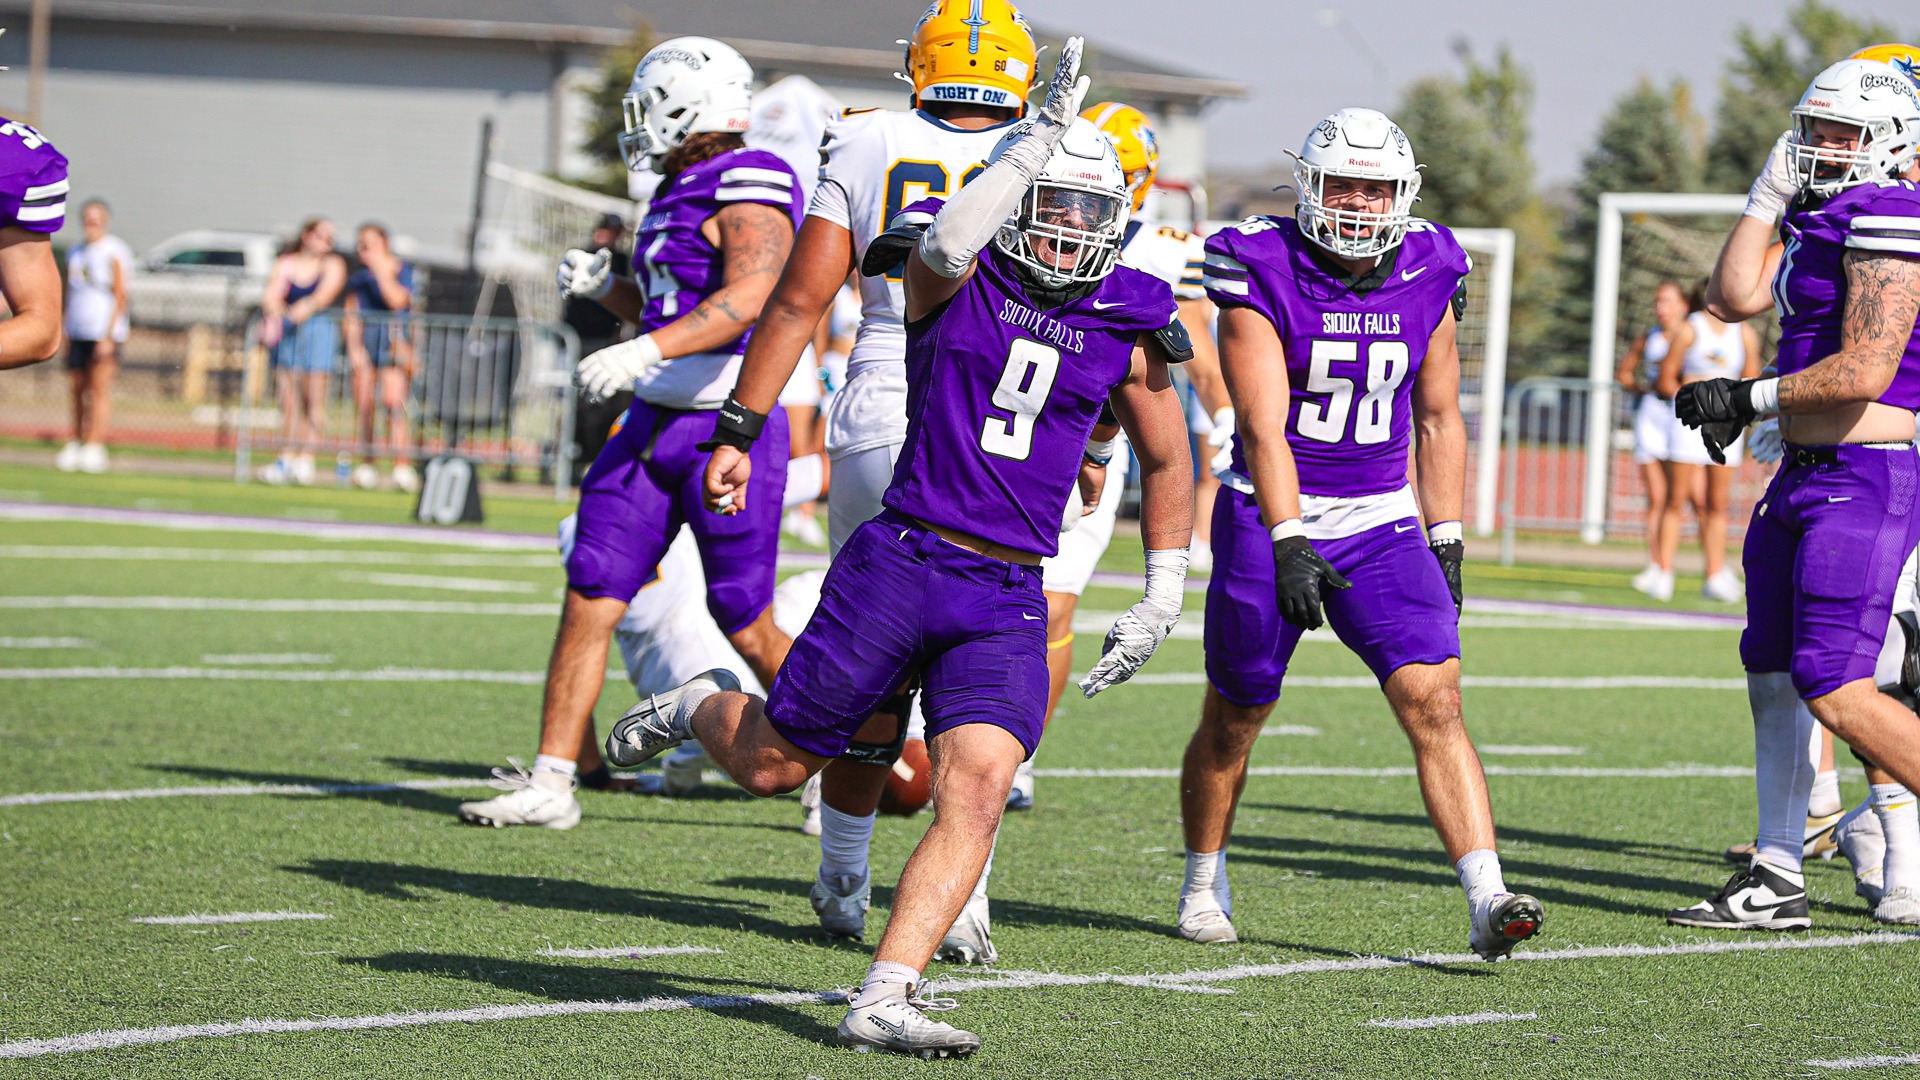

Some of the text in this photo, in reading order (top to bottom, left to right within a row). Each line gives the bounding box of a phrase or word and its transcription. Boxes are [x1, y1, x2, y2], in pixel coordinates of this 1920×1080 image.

[994, 59, 1007, 71] 60
[933, 86, 1008, 104] FIGHT ON!
[1347, 158, 1382, 168] Riddell
[879, 157, 987, 283] 6
[999, 298, 1085, 354] SIOUX FALLS
[1322, 312, 1400, 335] SIOUX FALLS
[979, 336, 1062, 463] 9
[1297, 339, 1410, 445] 58
[418, 457, 472, 525] 10
